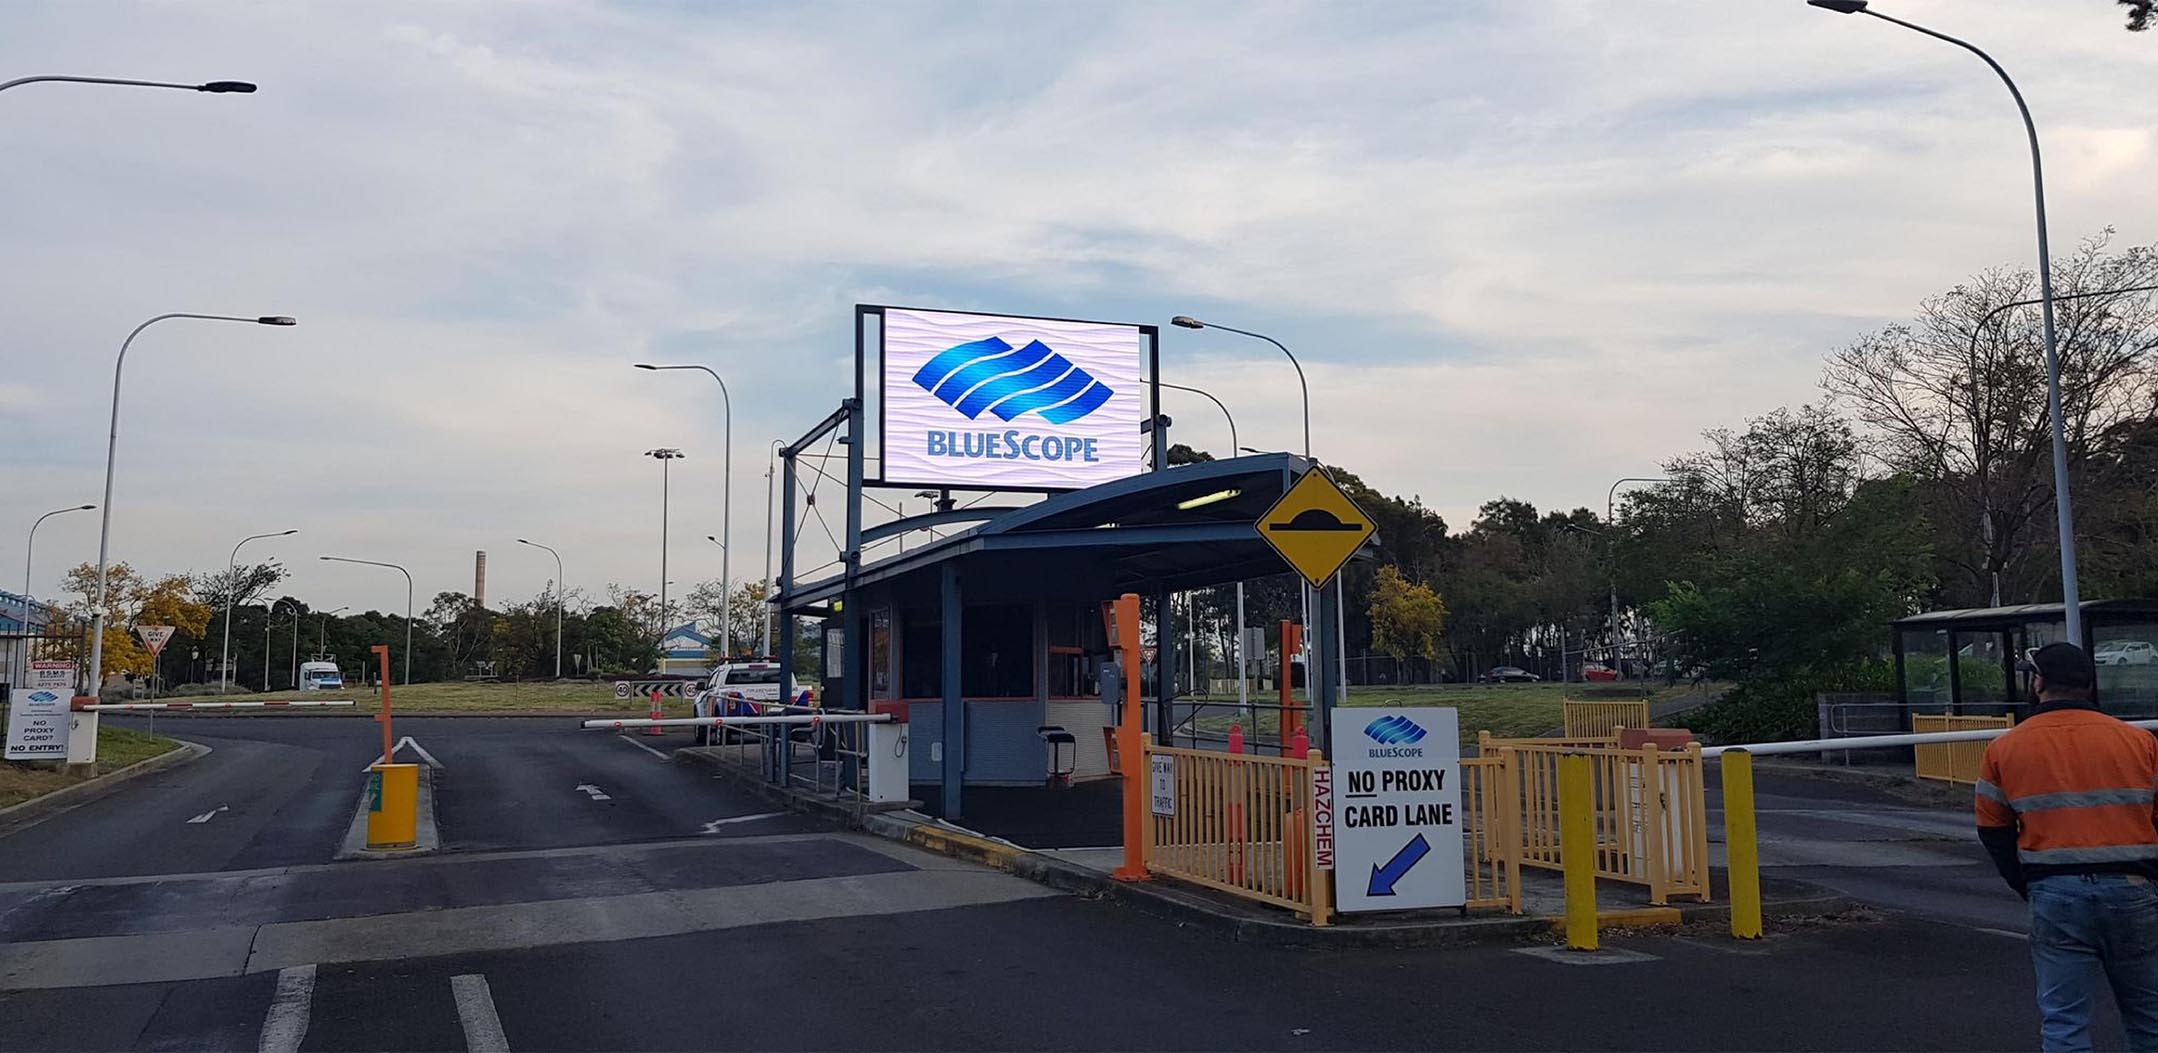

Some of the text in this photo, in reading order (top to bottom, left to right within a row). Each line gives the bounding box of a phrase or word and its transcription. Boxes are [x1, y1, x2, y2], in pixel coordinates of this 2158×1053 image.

[1348, 769, 1446, 793] NO PROXY
[1153, 795, 1173, 810] TRAFFIC
[1314, 769, 1333, 866] HAZCHEM
[1345, 803, 1453, 828] CARD LANE
